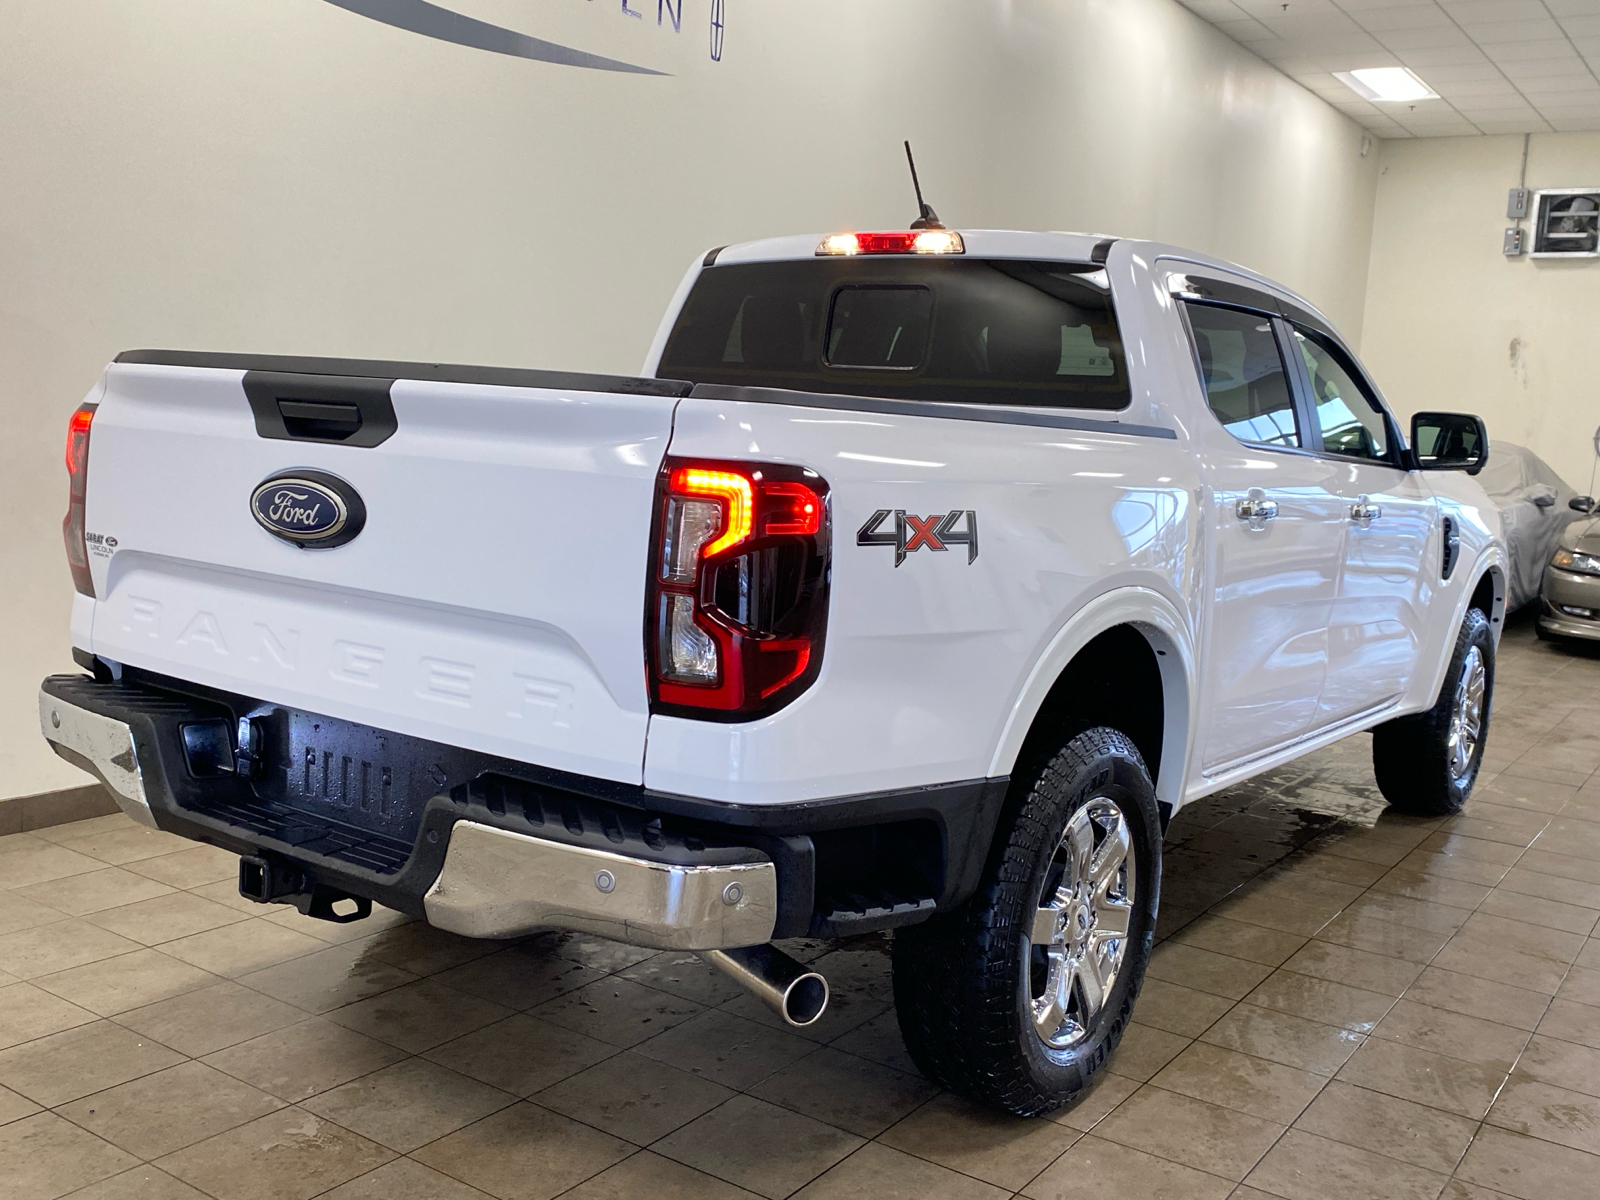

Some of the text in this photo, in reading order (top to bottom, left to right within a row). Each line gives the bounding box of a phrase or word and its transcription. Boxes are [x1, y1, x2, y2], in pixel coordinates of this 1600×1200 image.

[269, 490, 319, 526] Ford
[90, 543, 114, 555] LINCOLN
[121, 594, 576, 729] RANGER
